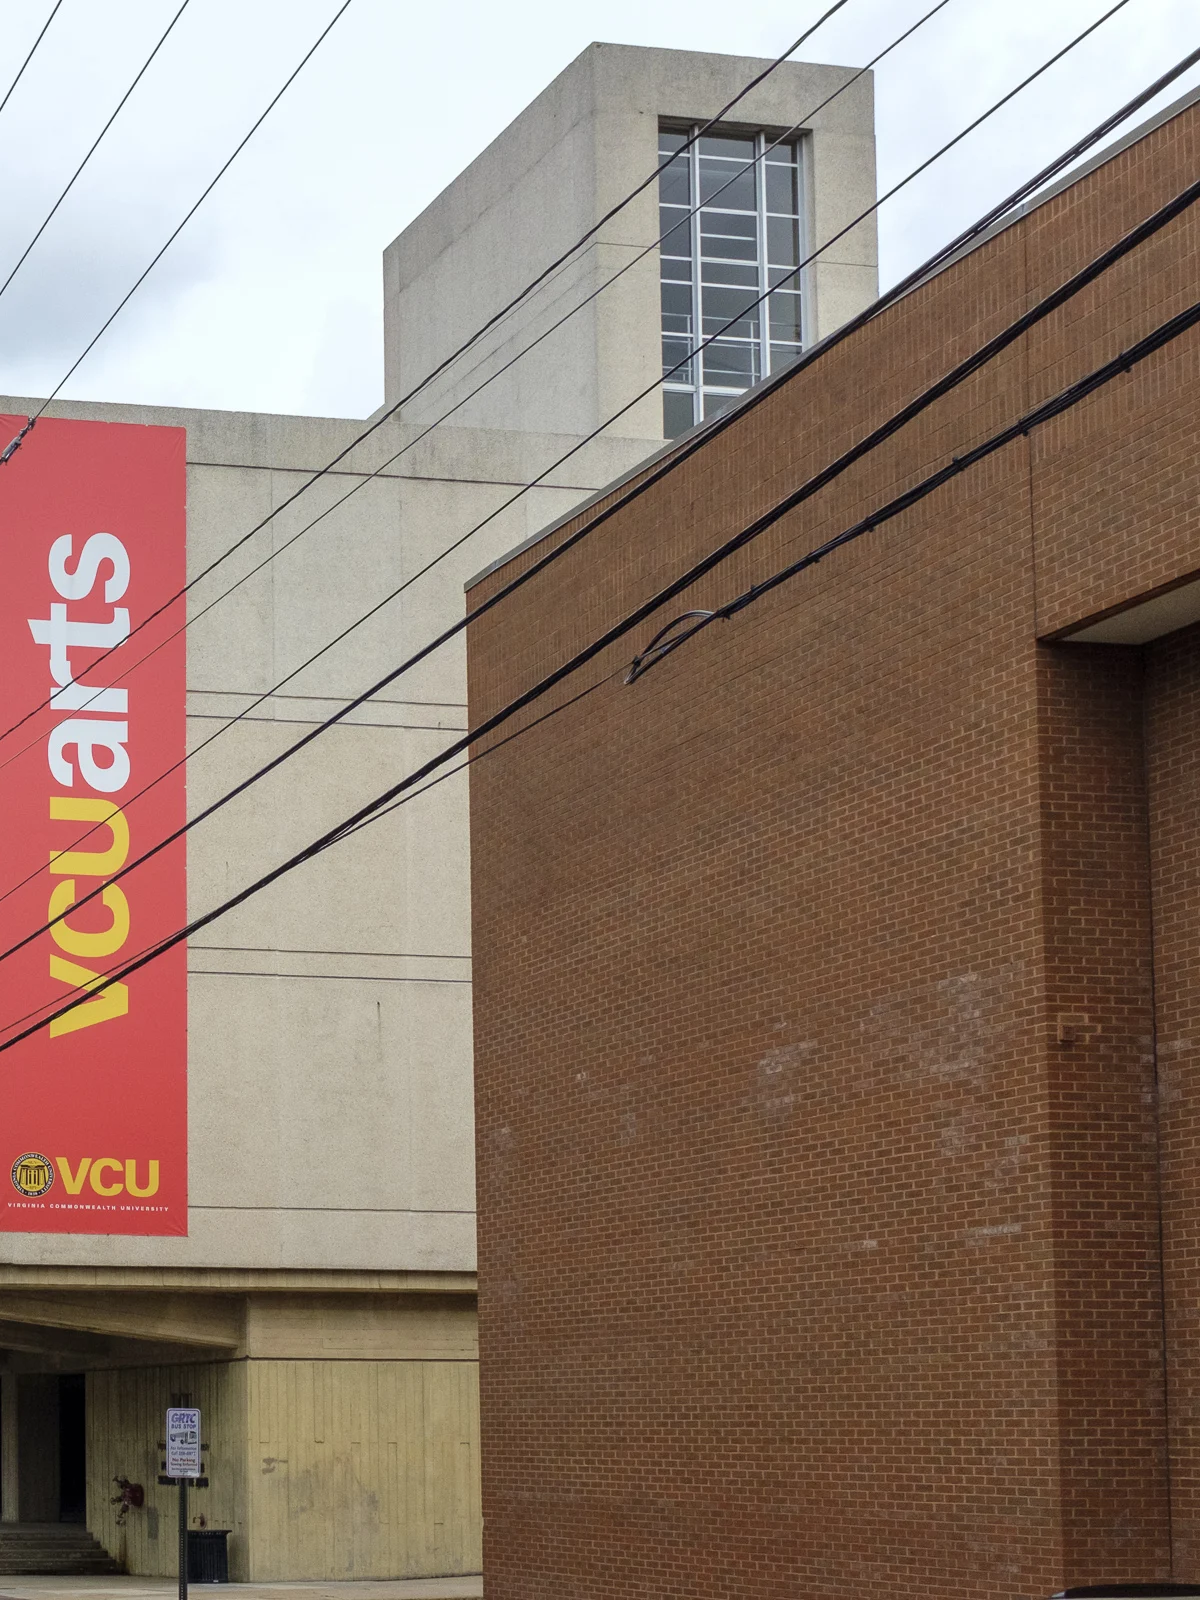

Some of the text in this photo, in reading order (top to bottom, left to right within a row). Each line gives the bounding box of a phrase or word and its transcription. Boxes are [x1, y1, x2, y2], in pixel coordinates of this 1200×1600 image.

[55, 1157, 159, 1197] VCU
[49, 1203, 116, 1211] COMMONWEALTH
[171, 1412, 196, 1423] GRTC
